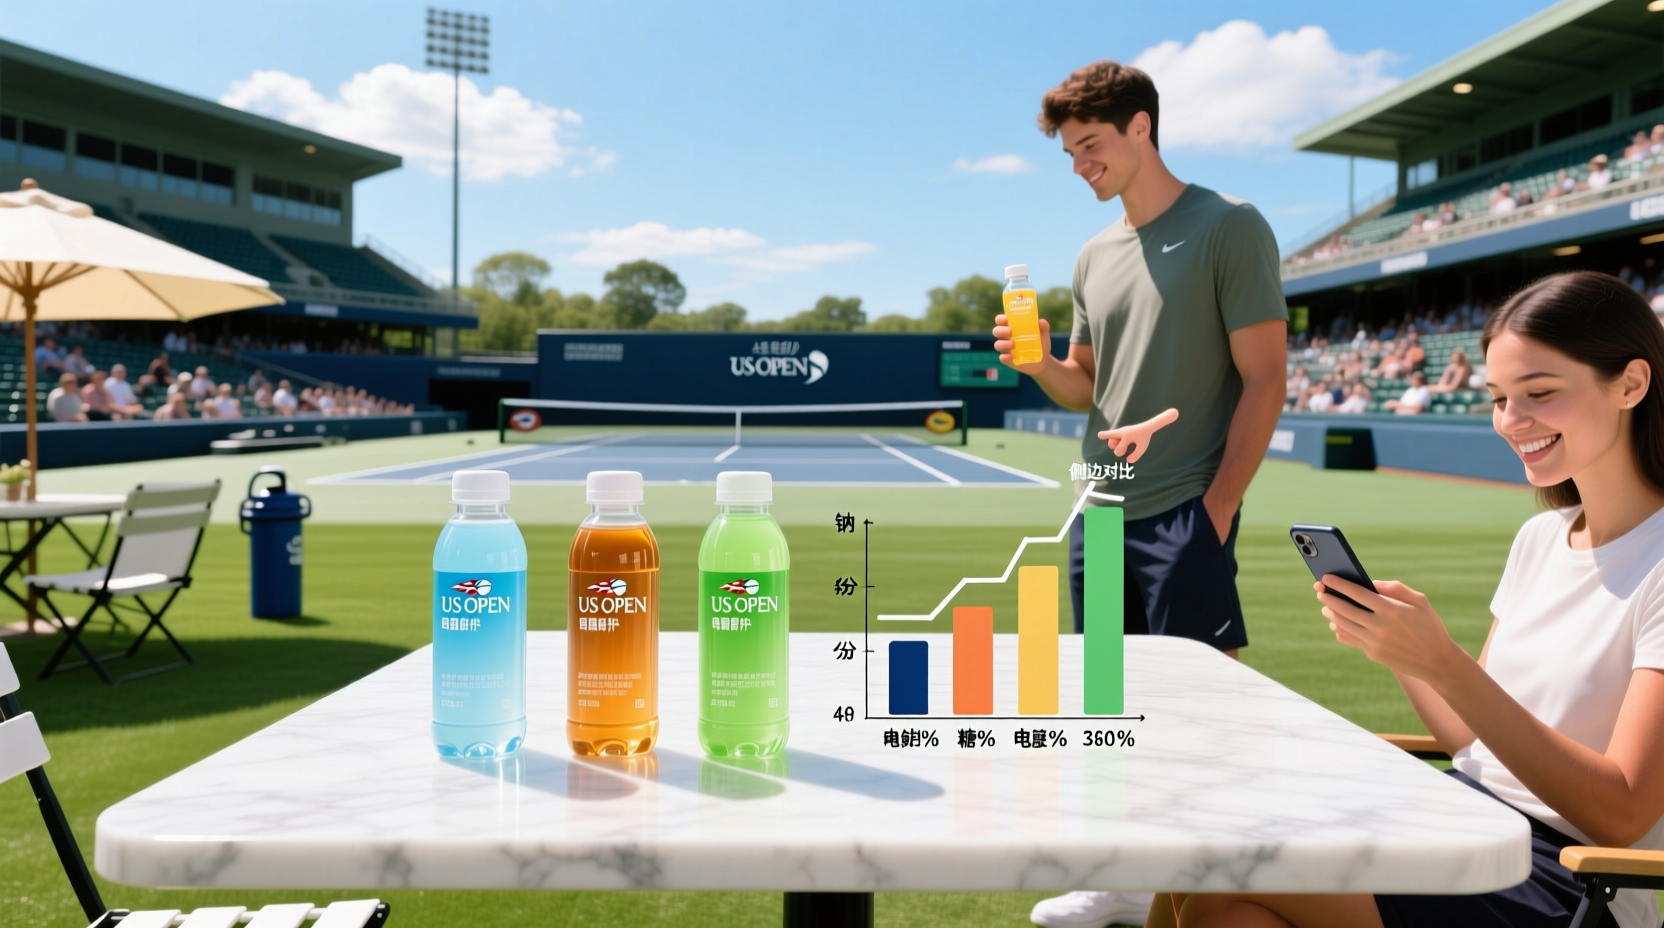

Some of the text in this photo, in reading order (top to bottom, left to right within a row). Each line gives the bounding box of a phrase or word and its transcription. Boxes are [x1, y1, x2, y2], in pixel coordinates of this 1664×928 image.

[442, 596, 510, 614] US OPEN
[578, 596, 647, 614] US OPEN
[711, 595, 778, 613] US OPEN
